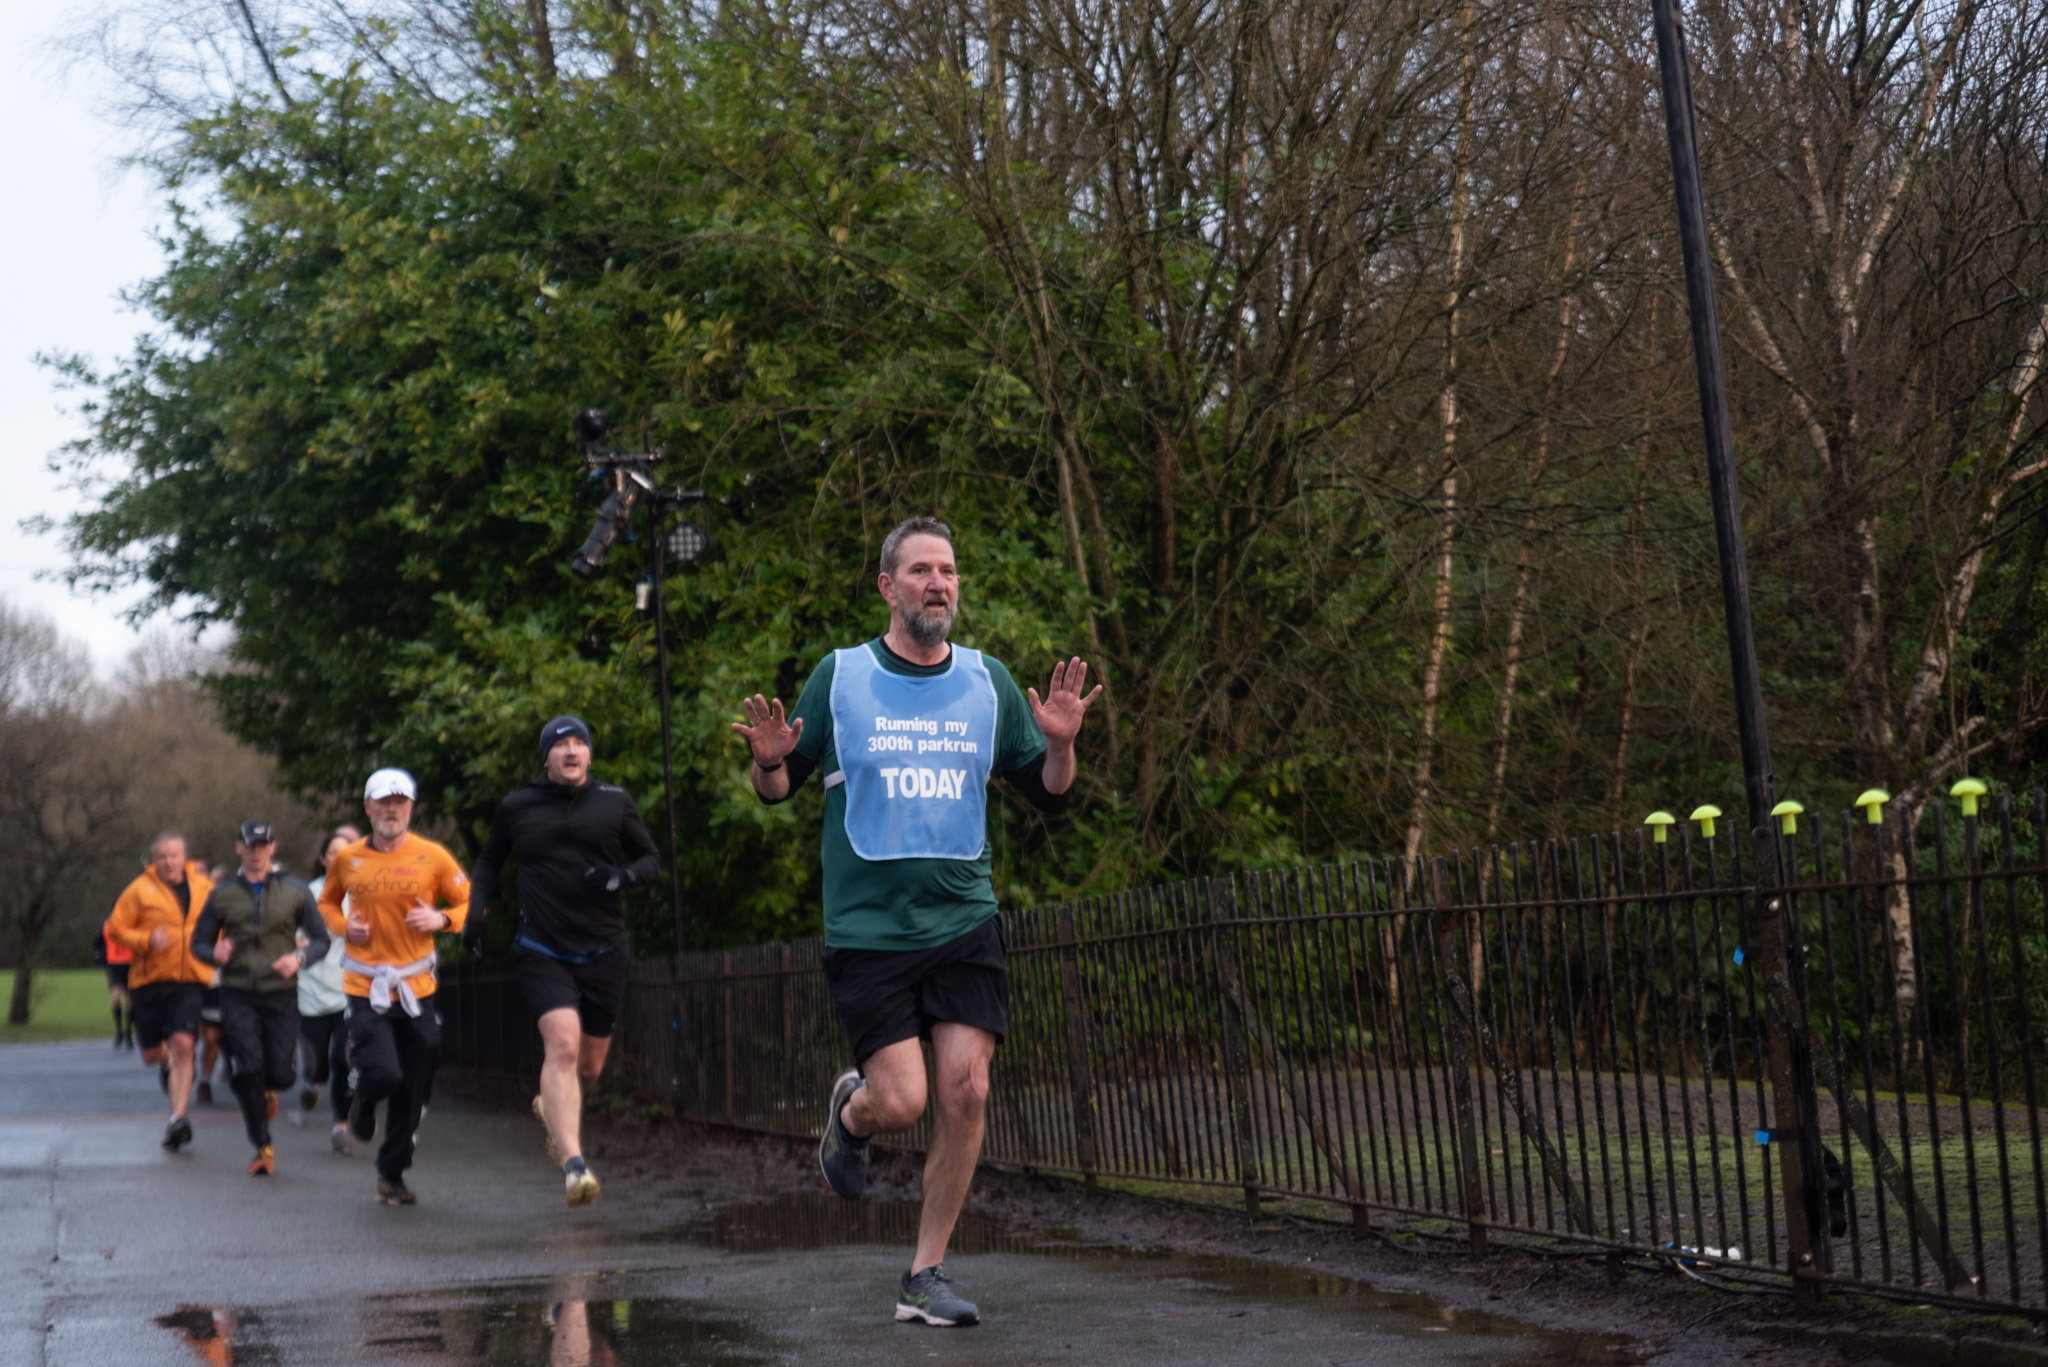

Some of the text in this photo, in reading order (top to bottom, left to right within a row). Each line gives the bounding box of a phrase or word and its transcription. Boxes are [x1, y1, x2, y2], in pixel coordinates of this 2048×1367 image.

[875, 717, 968, 736] Running my
[867, 736, 977, 754] 300th parkrun
[880, 767, 967, 799] TODAY
